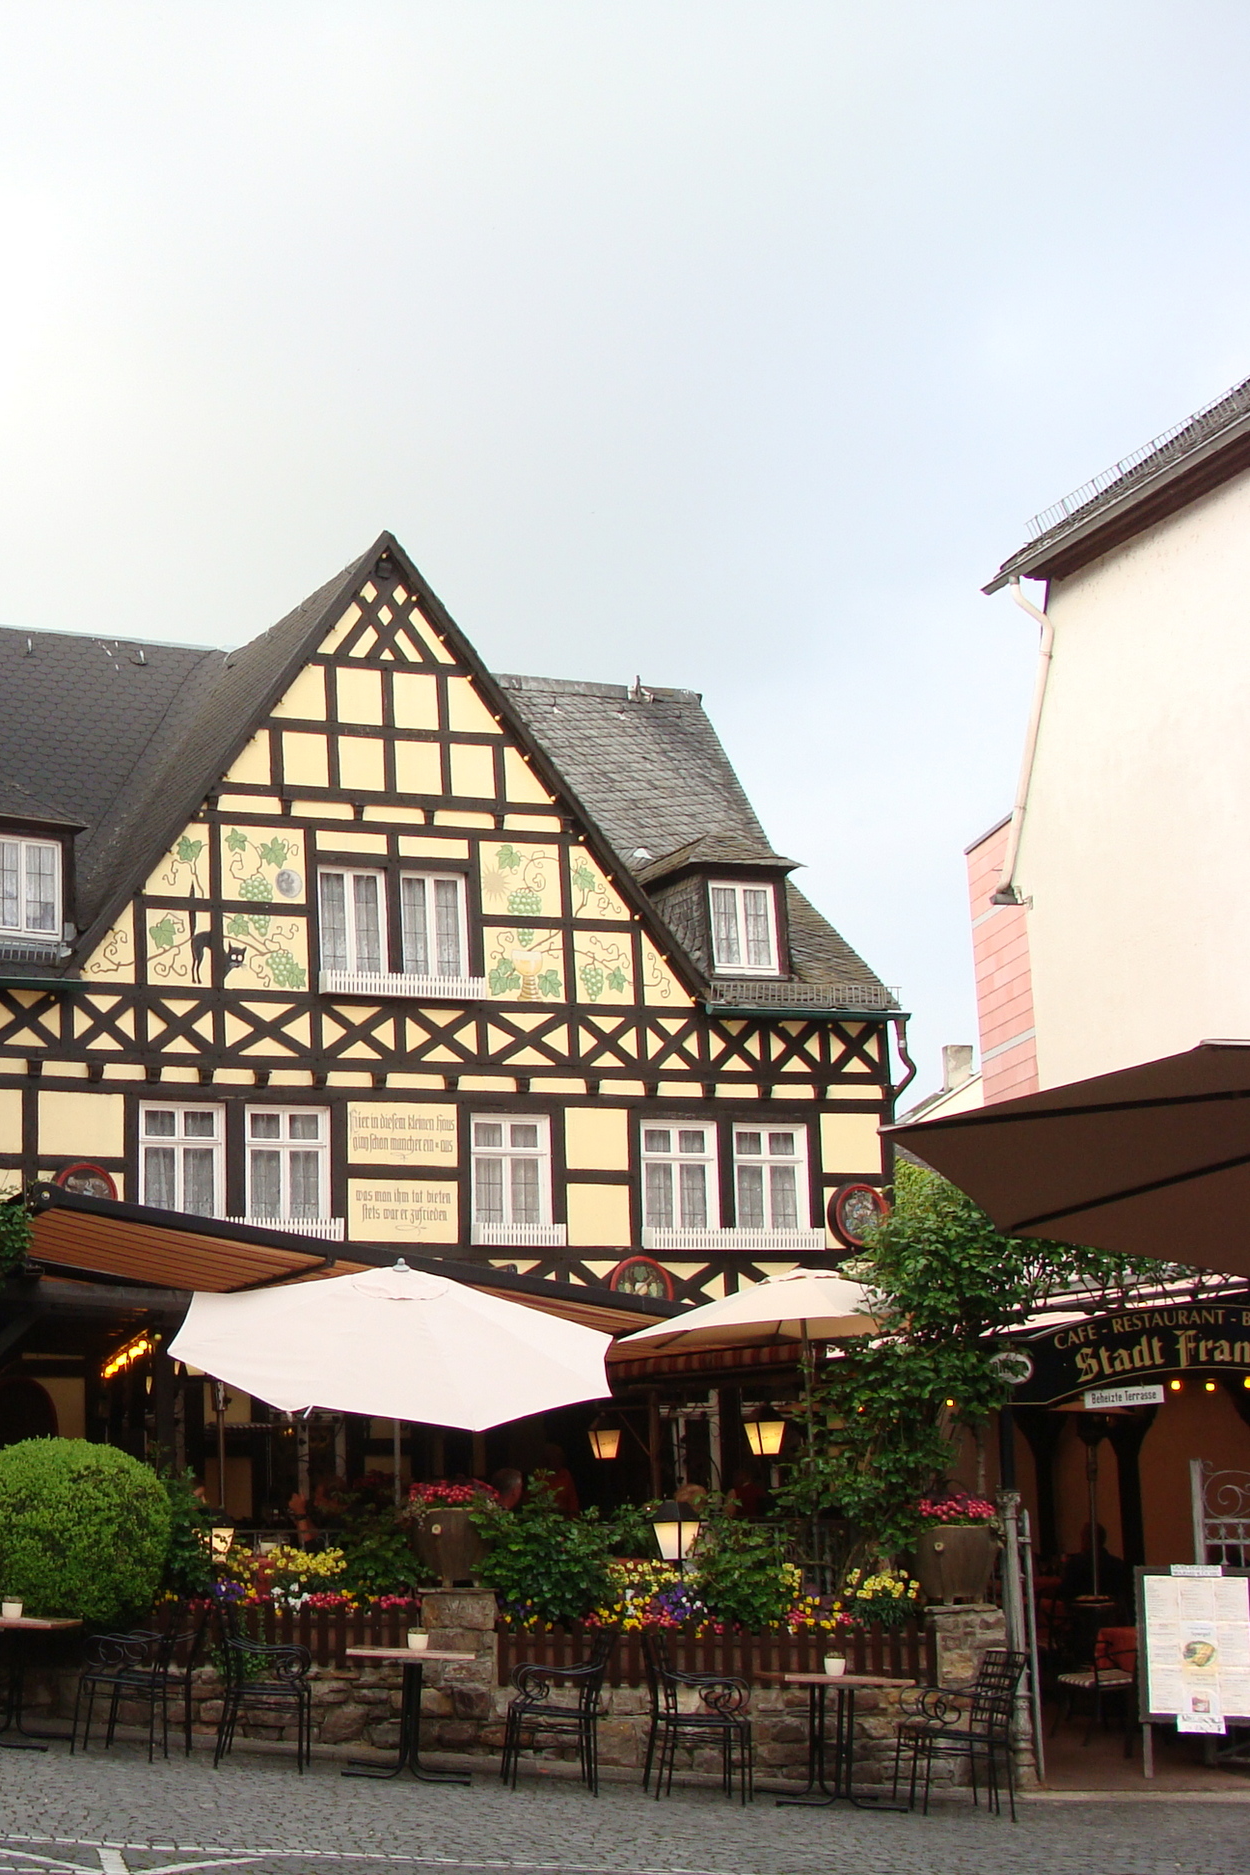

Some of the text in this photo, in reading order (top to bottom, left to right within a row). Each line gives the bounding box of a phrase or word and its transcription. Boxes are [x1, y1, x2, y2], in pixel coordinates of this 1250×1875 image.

[371, 1113, 379, 1129] in
[355, 1189, 373, 1201] was
[374, 1190, 392, 1203] man
[393, 1187, 409, 1205] ihm
[412, 1189, 423, 1203] tat
[400, 1208, 408, 1220] er
[1053, 1324, 1098, 1350] CAFE
[1111, 1310, 1226, 1334] RESTAURANT
[1075, 1334, 1166, 1383] Stadt
[1091, 1390, 1157, 1404] Beheizte Terrasse
